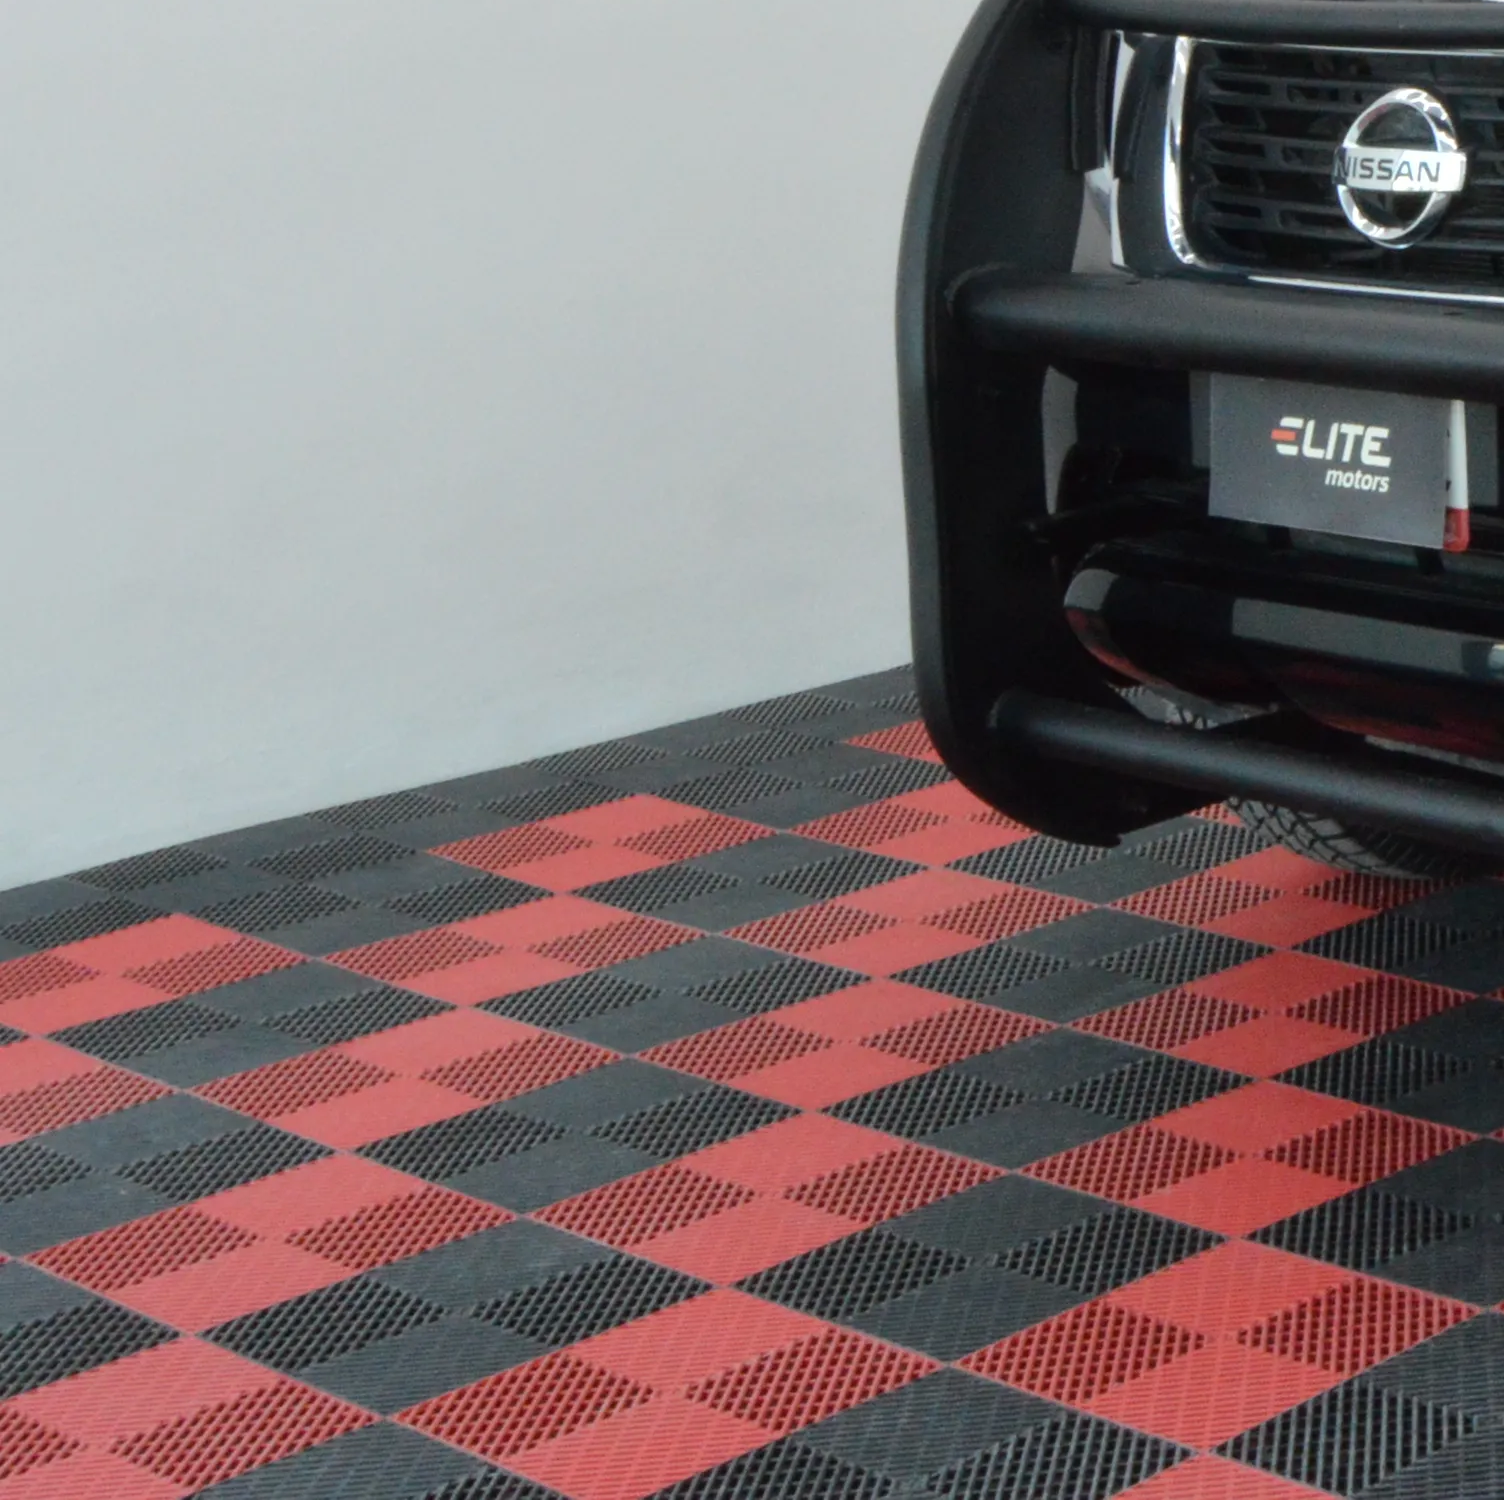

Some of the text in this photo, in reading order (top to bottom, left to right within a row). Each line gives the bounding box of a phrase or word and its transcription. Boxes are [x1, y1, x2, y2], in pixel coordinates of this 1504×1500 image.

[1333, 155, 1441, 183] NISSAN
[1271, 416, 1392, 469] ELITE
[1324, 467, 1391, 494] motors
